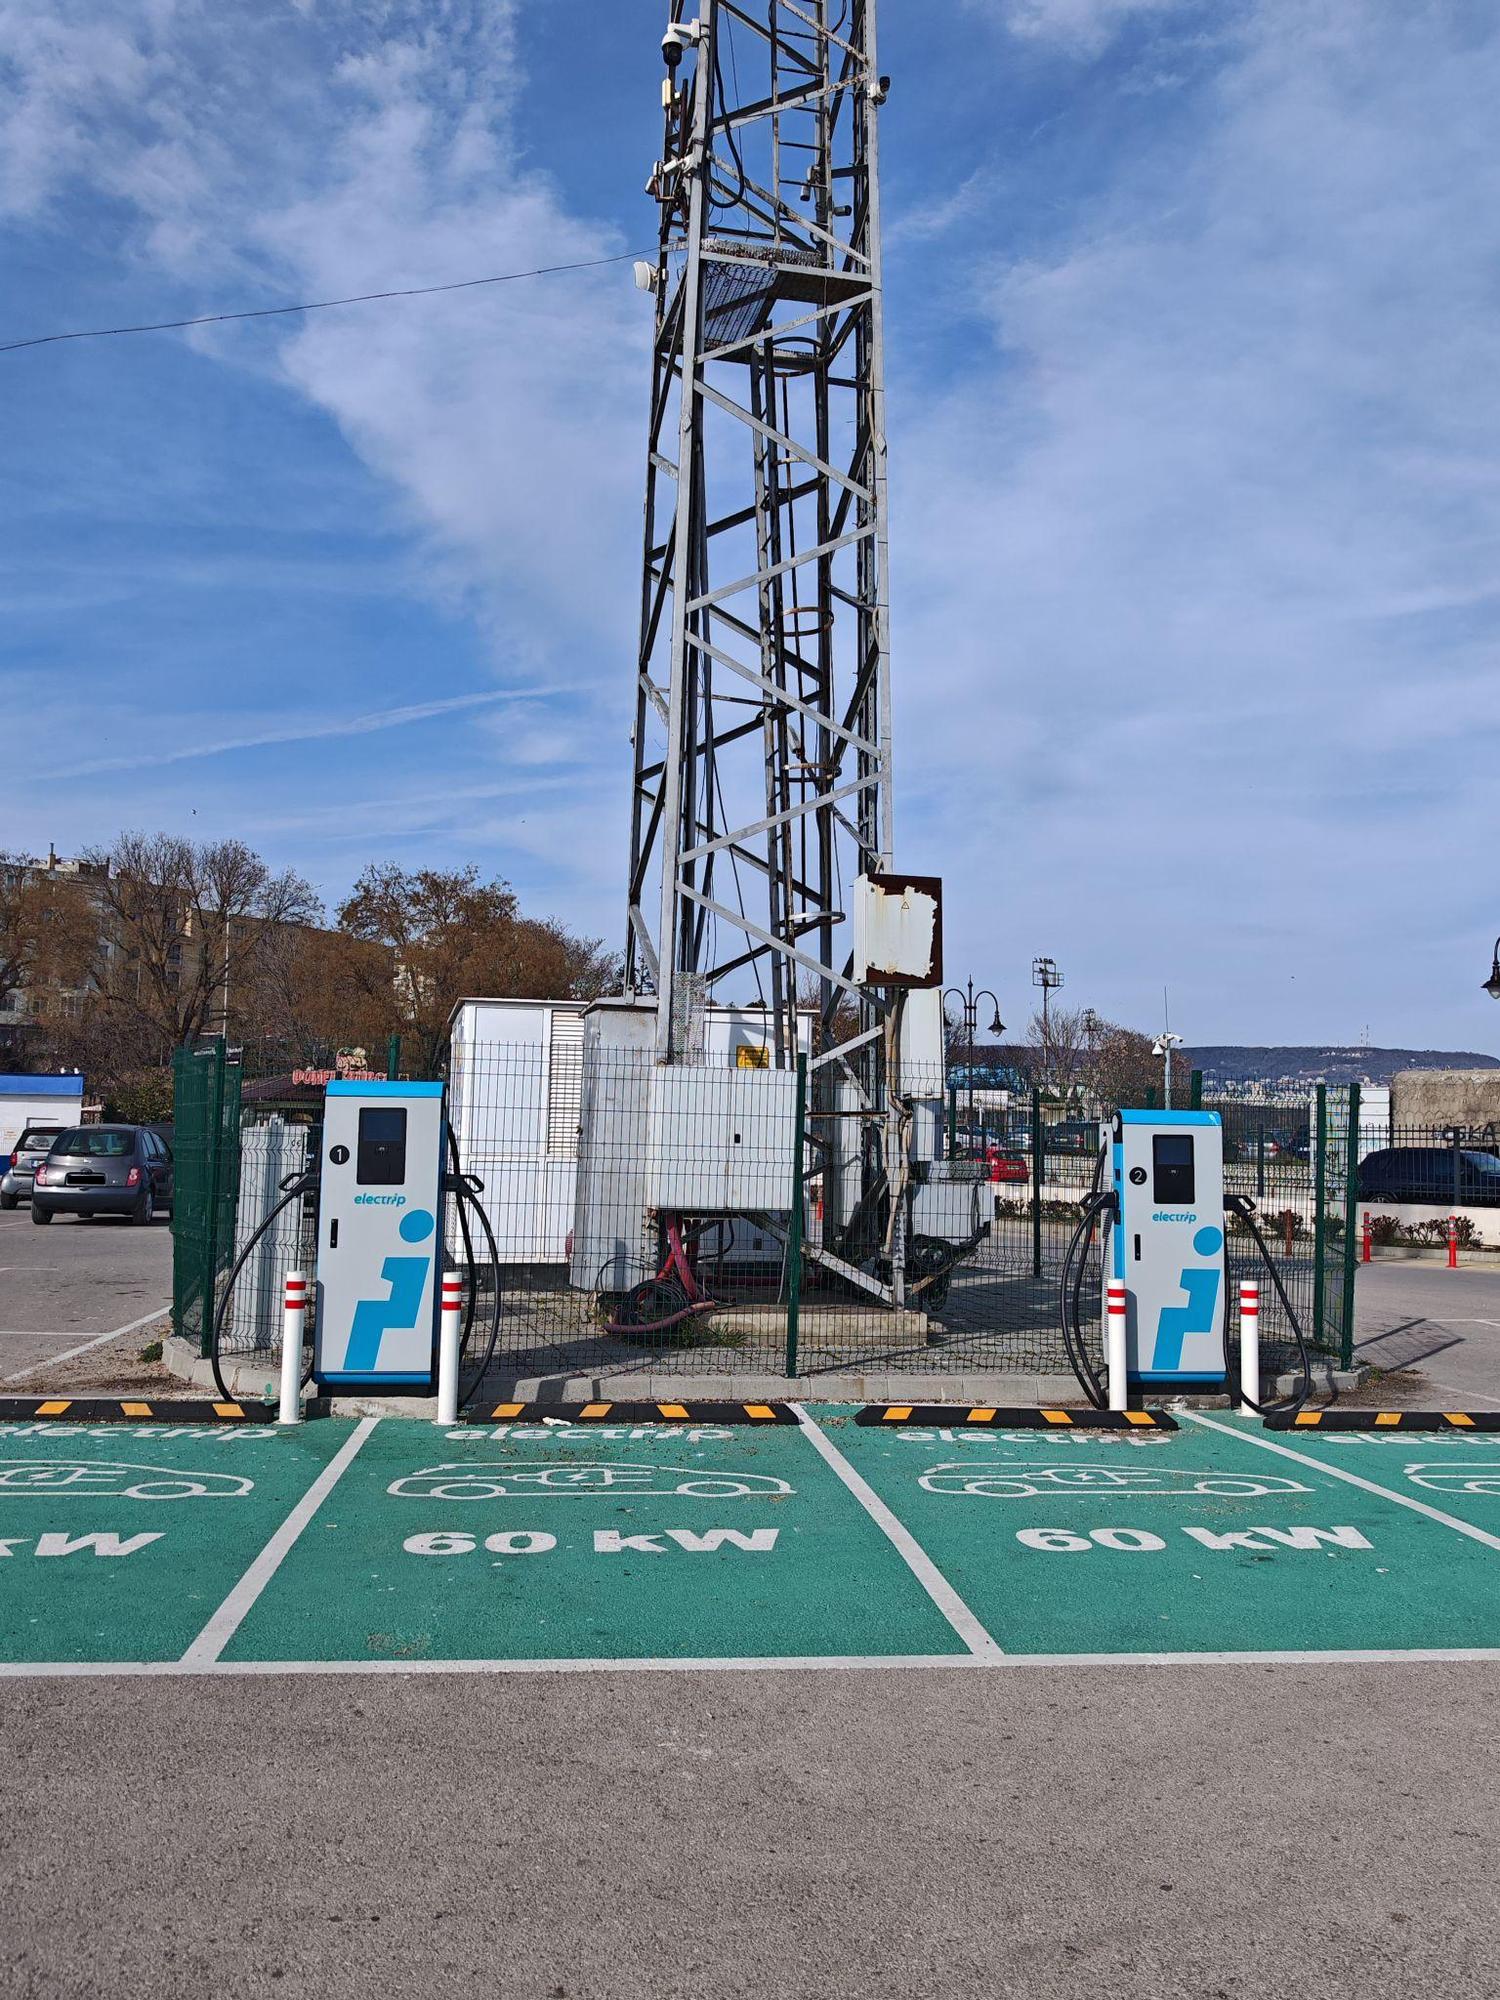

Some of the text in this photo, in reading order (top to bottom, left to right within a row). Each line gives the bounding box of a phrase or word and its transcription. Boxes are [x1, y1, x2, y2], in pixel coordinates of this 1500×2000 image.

[336, 1148, 342, 1162] 1
[1134, 1170, 1143, 1183] 2
[353, 1193, 406, 1207] electrip
[1152, 1211, 1197, 1224] electrip
[444, 1427, 734, 1441] electrip
[895, 1430, 1172, 1446] electrip
[402, 1528, 780, 1555] 60 kW
[1015, 1526, 1374, 1551] 60 kW
